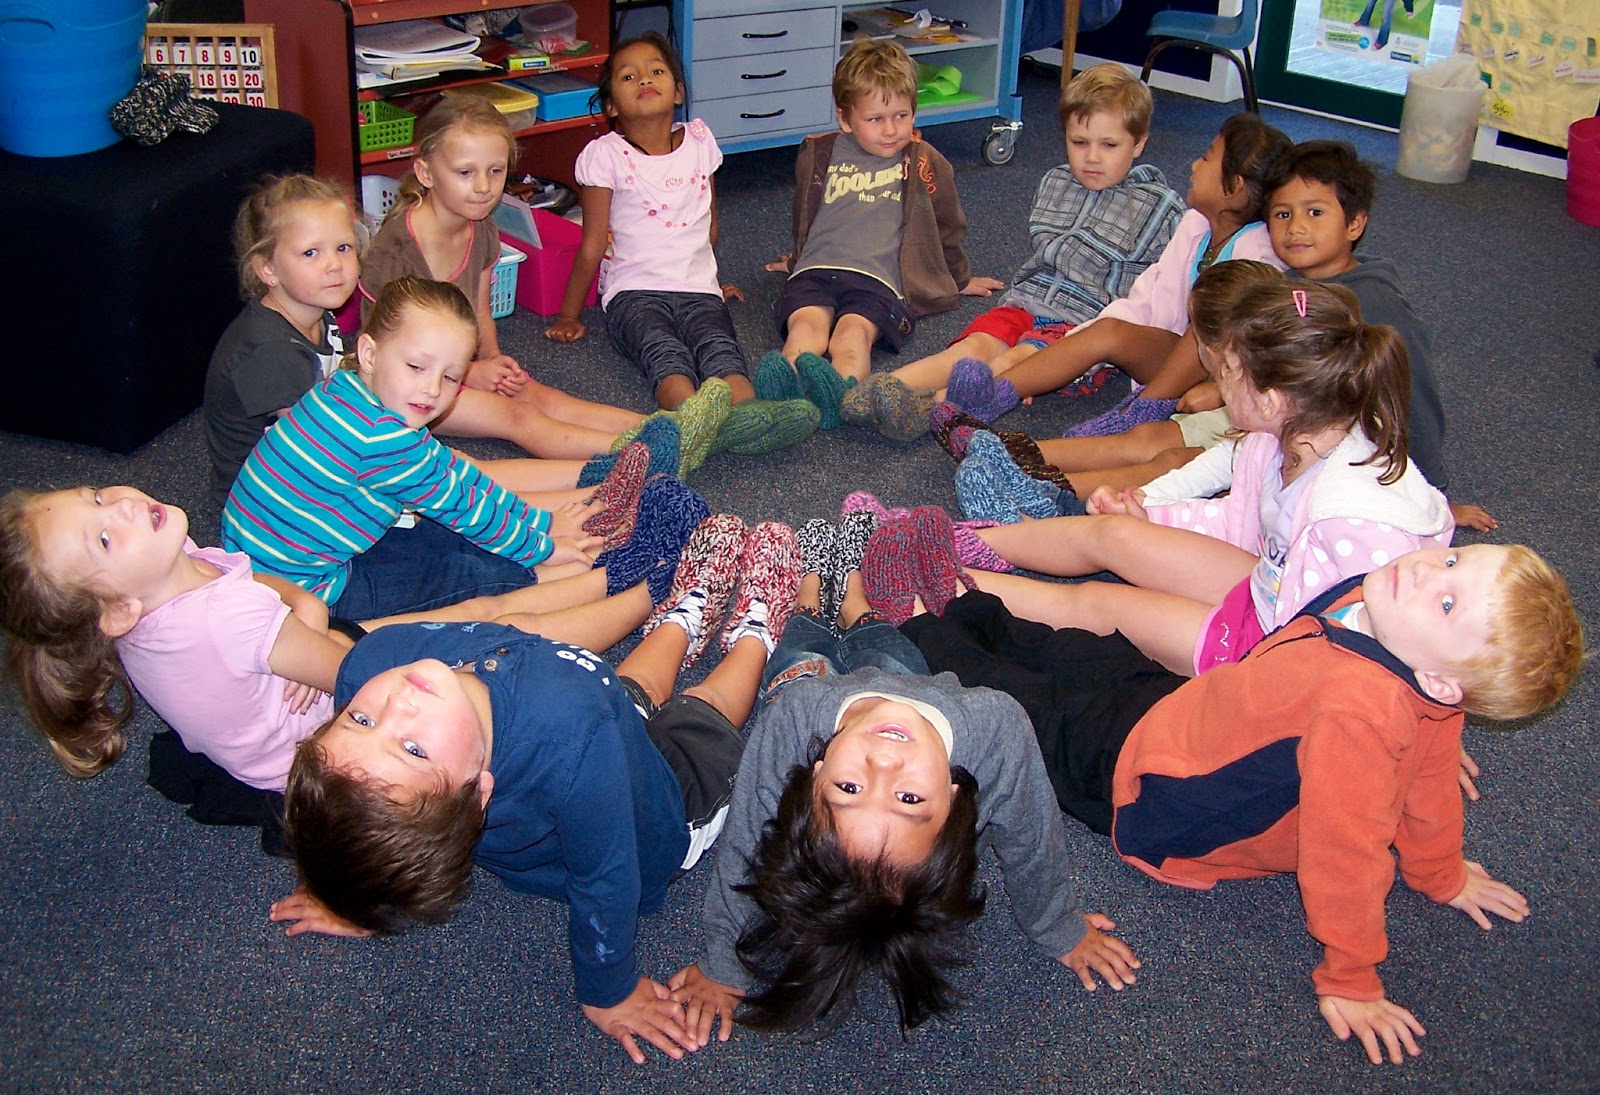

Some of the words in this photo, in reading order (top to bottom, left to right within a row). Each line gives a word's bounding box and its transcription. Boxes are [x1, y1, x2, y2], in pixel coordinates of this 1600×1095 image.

[156, 49, 164, 62] 6
[178, 50, 186, 62] 7
[201, 50, 209, 62] 8
[224, 50, 232, 63] 9
[241, 50, 257, 63] 10
[199, 73, 215, 86] 18
[222, 73, 237, 86] 19
[244, 73, 259, 86] 20
[249, 96, 263, 108] 30
[827, 164, 838, 173] my
[839, 162, 859, 173] dad's
[858, 191, 875, 203] than
